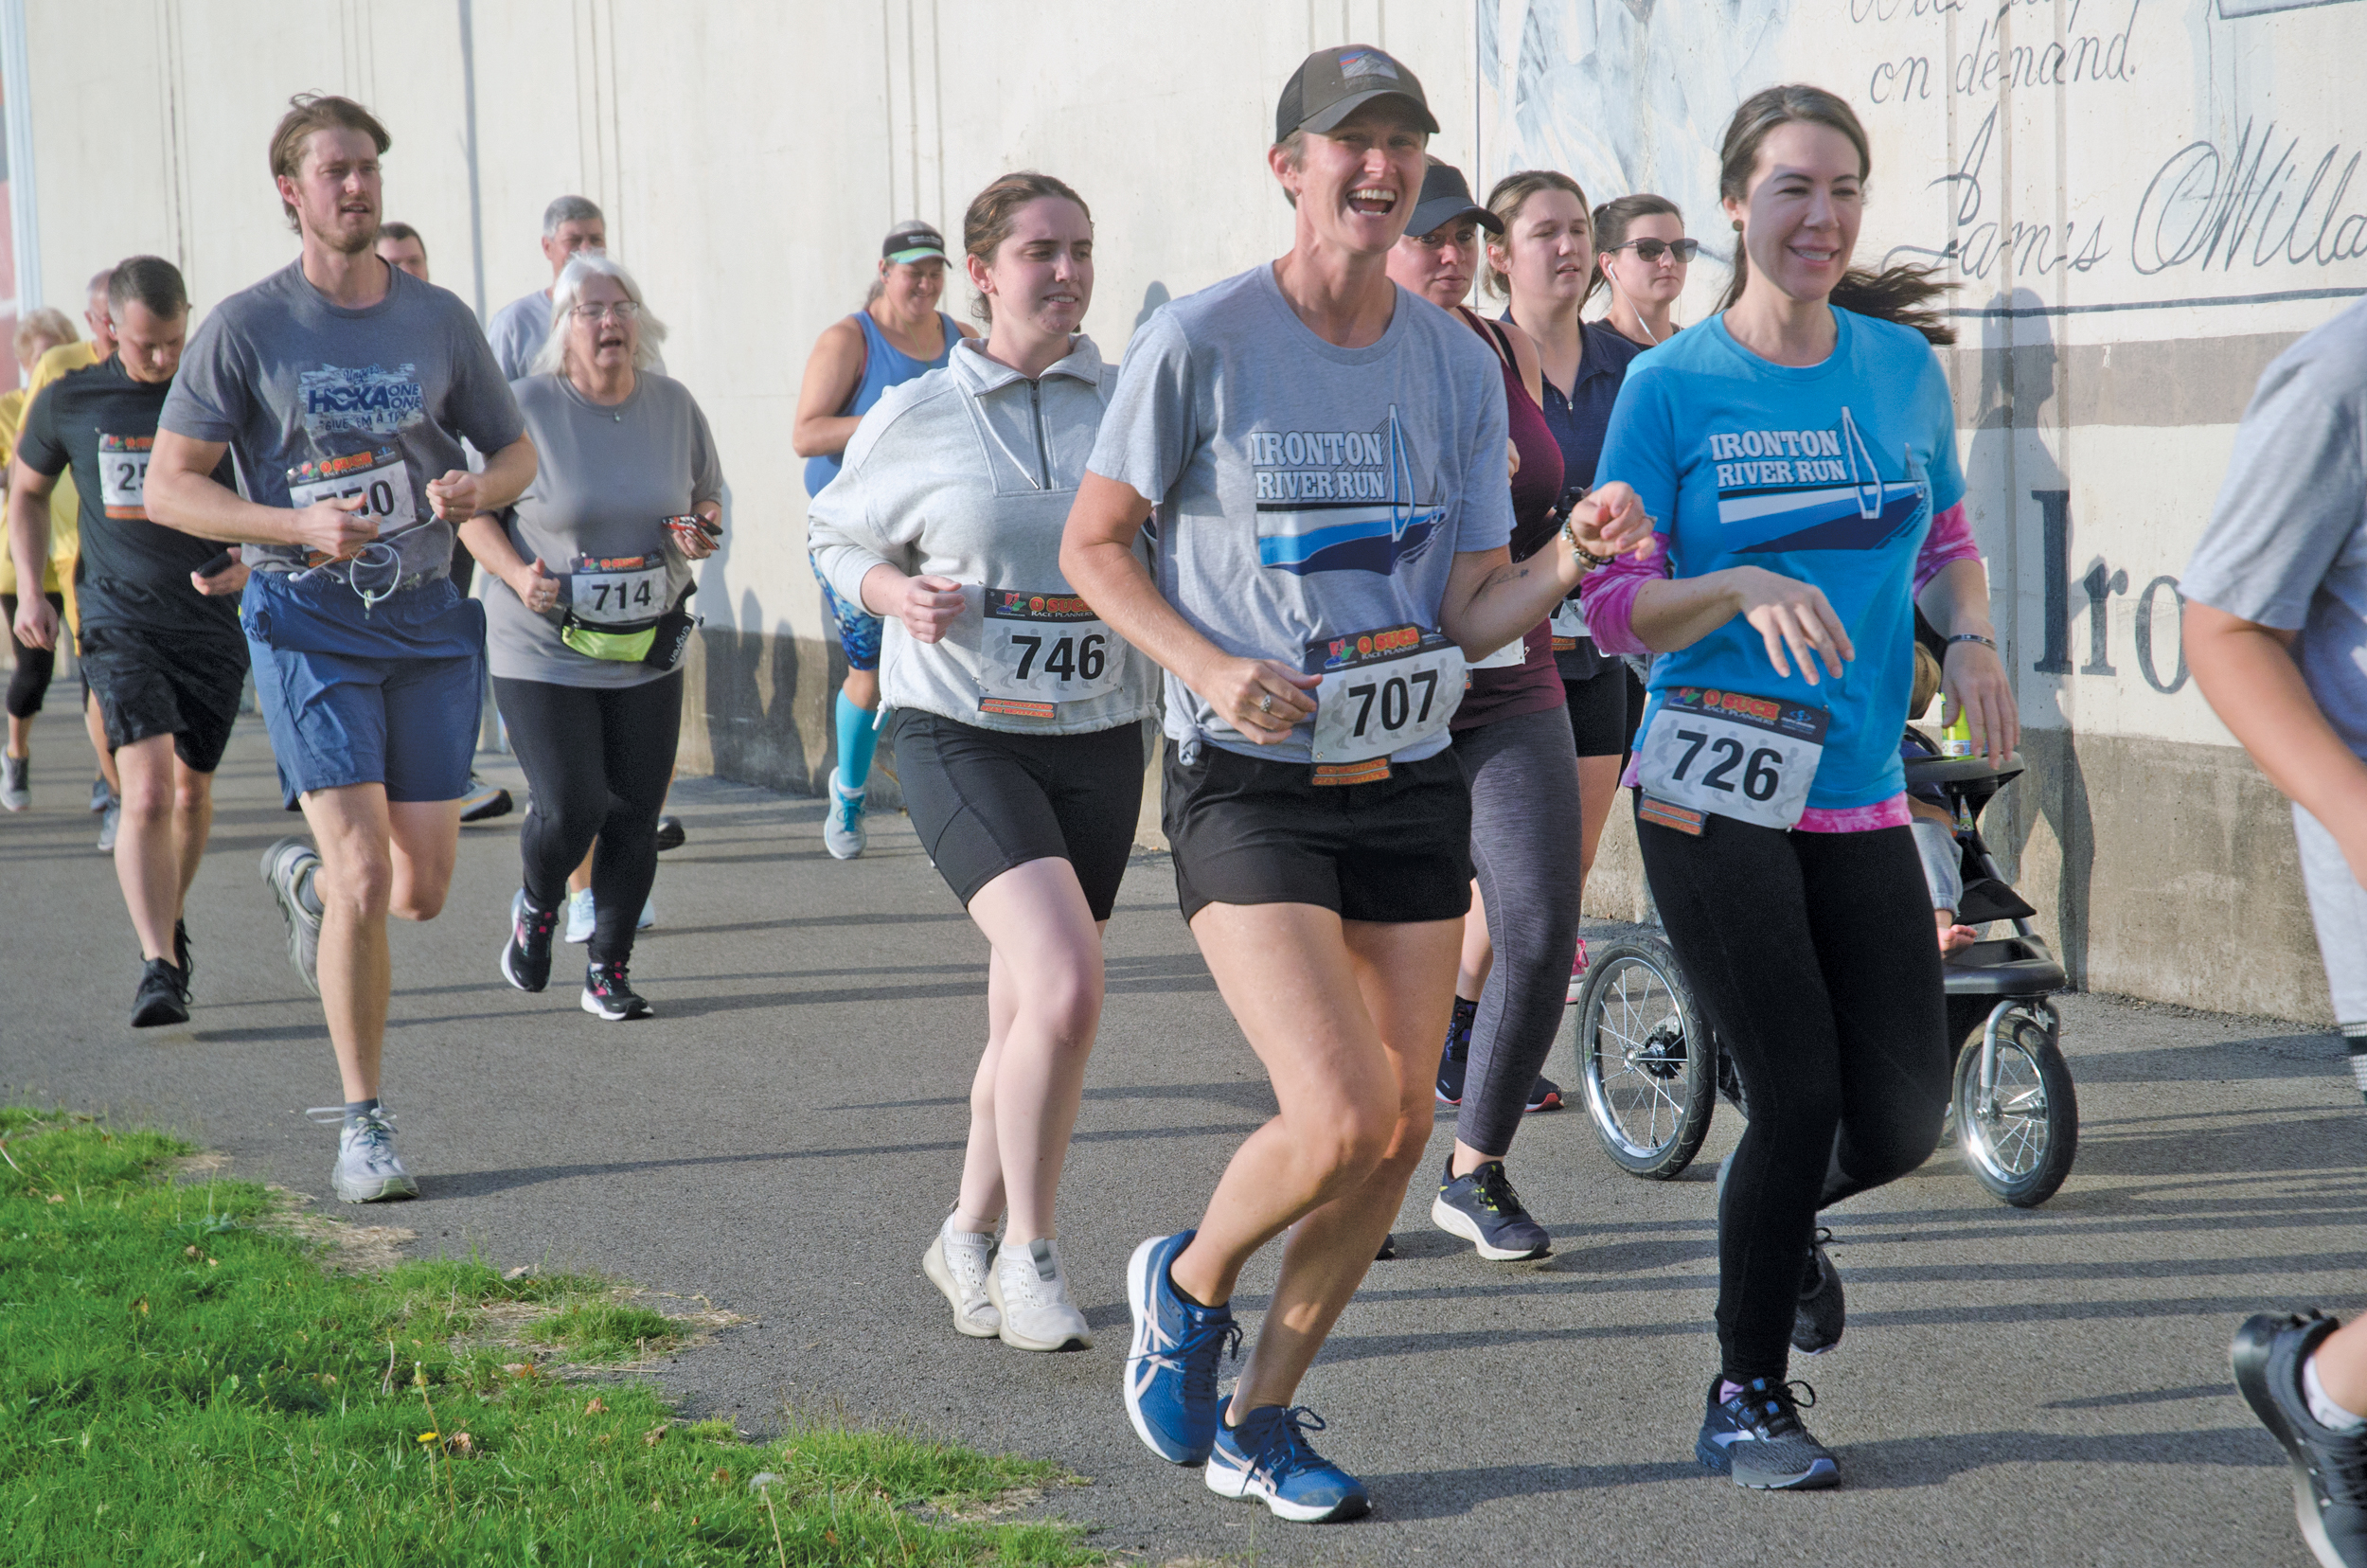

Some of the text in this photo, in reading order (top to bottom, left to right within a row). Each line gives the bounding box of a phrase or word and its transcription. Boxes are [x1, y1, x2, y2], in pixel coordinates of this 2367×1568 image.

[1870, 57, 1931, 104] on
[308, 383, 419, 414] HOKA ONE
[390, 396, 421, 410] ONE
[1251, 431, 1383, 466] IRONTON
[1709, 430, 1842, 461] IRONTON
[331, 451, 373, 472] SUCH
[1717, 459, 1847, 488] RIVER RUN
[314, 479, 394, 516] 50
[1255, 471, 1385, 499] RIVER RUN
[592, 579, 651, 611] 714
[1029, 597, 1045, 612] O
[1358, 636, 1372, 654] O
[1374, 627, 1419, 651] SUCH
[1011, 633, 1106, 681] 746
[1348, 668, 1438, 737] 707
[1703, 689, 1781, 721] O SUCH
[1672, 729, 1783, 801] 726
